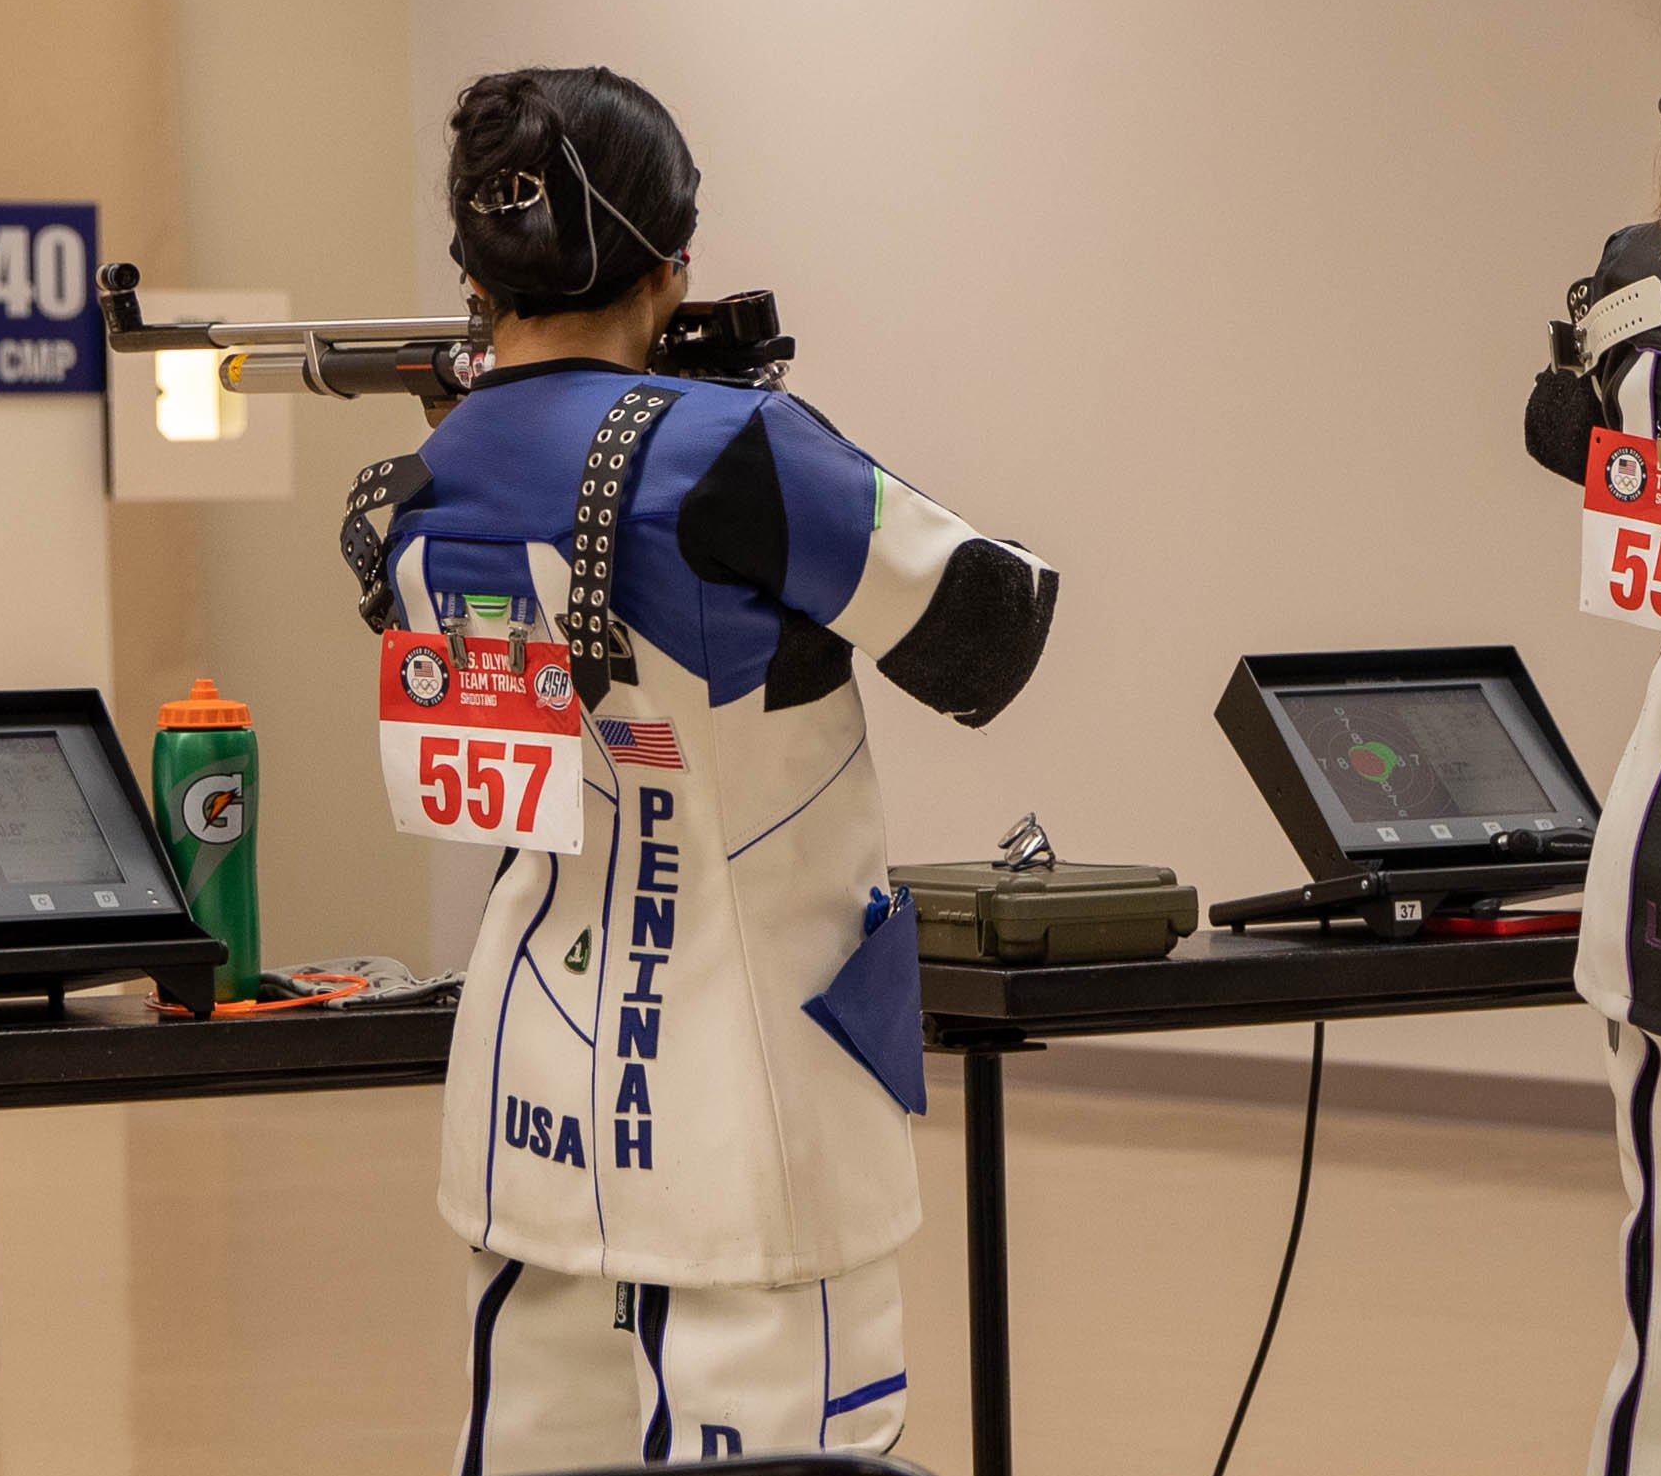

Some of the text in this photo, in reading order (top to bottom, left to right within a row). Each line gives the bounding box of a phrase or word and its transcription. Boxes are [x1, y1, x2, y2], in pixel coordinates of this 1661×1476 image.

[458, 670, 527, 694] TEAM TRIALS
[182, 773, 245, 845] G
[418, 735, 553, 834] 557
[1400, 904, 1416, 919] 37
[613, 786, 680, 1171] PENINAH
[504, 1094, 587, 1170] USA
